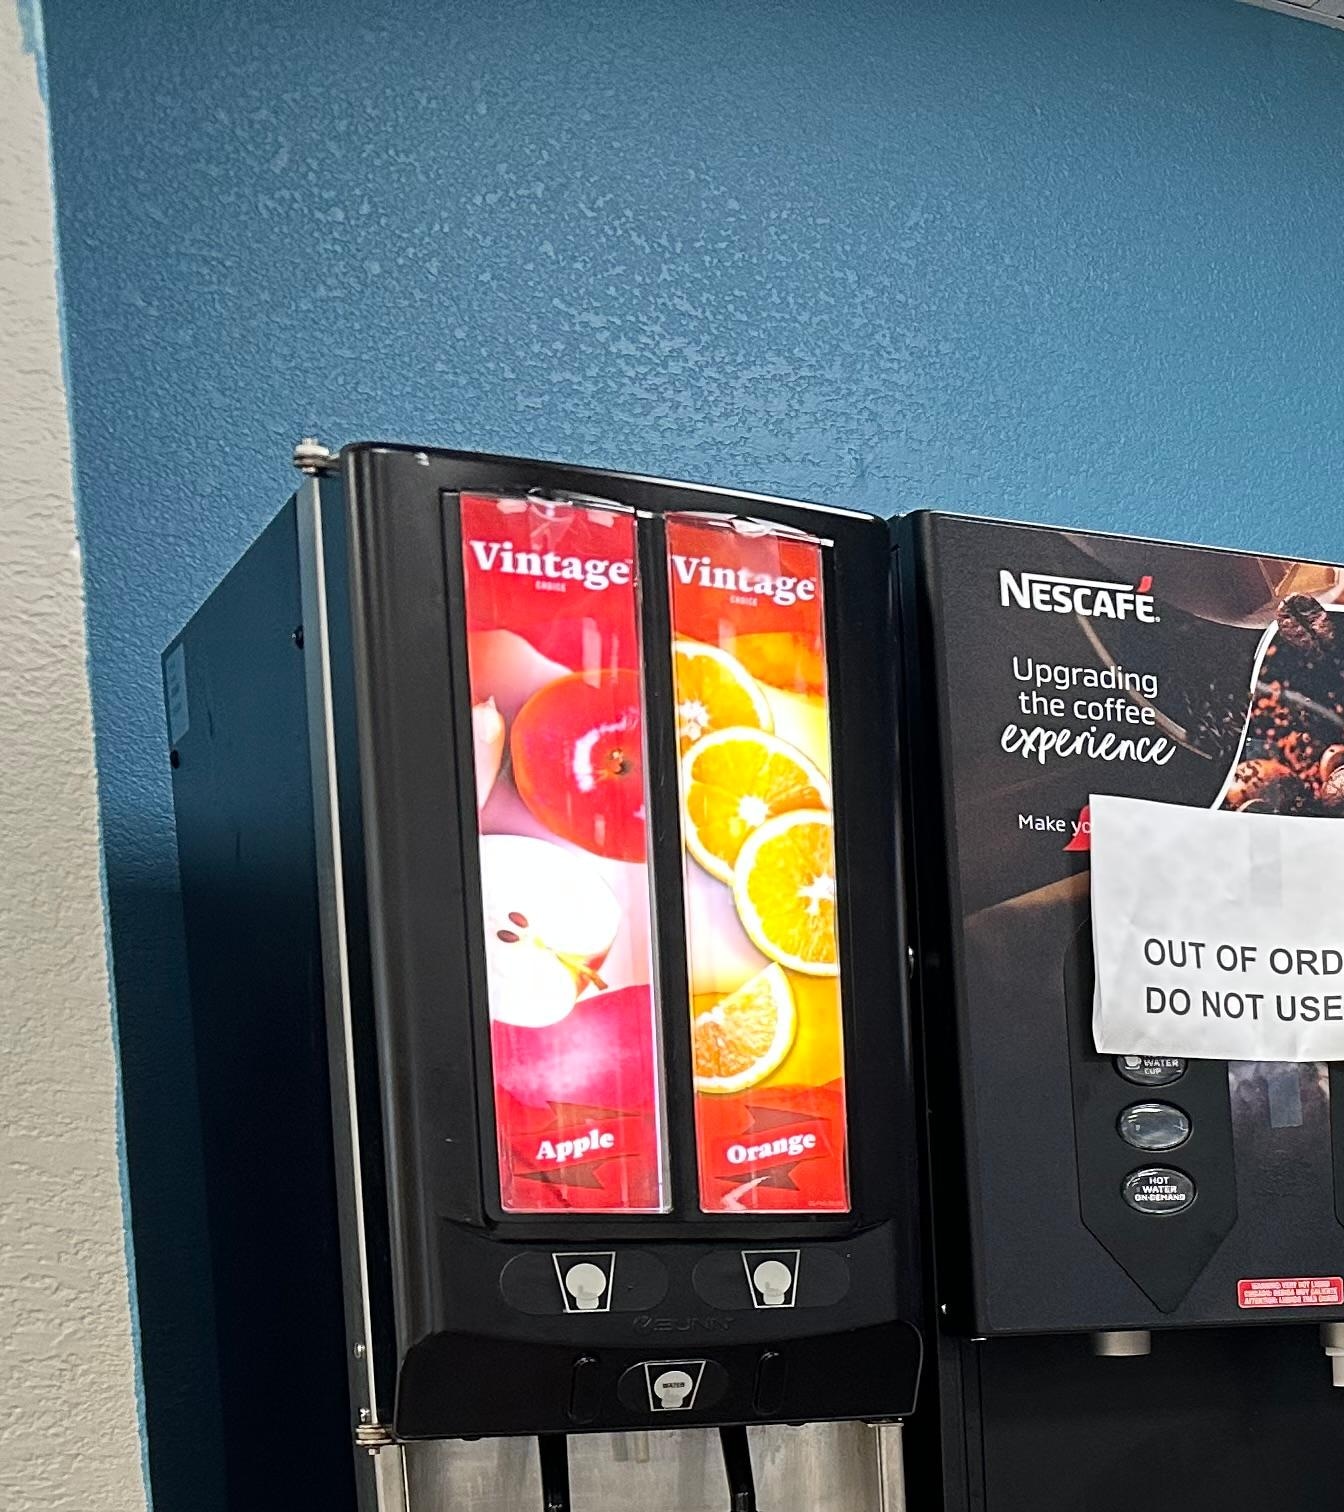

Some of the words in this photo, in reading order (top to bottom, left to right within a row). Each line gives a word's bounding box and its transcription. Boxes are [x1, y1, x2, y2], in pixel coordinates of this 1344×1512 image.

[469, 540, 630, 591] Vintage
[672, 555, 816, 607] Vintage
[1000, 570, 1155, 623] NESCAFÉ
[1013, 657, 1158, 698] Upgrading
[1019, 691, 1065, 716] the
[1074, 699, 1156, 726] coffee
[1001, 724, 1176, 764] experience
[1018, 814, 1066, 832] Make
[1144, 938, 1206, 969] OUT
[1216, 944, 1257, 972] OF
[1146, 986, 1191, 1016] DO
[1202, 991, 1264, 1020] NOT
[1276, 995, 1344, 1021] USE
[1143, 1058, 1179, 1067] WATER
[536, 1129, 615, 1162] Apple
[727, 1132, 816, 1165] Orange
[1142, 1185, 1177, 1194] WATER
[1149, 1176, 1170, 1185] HOT
